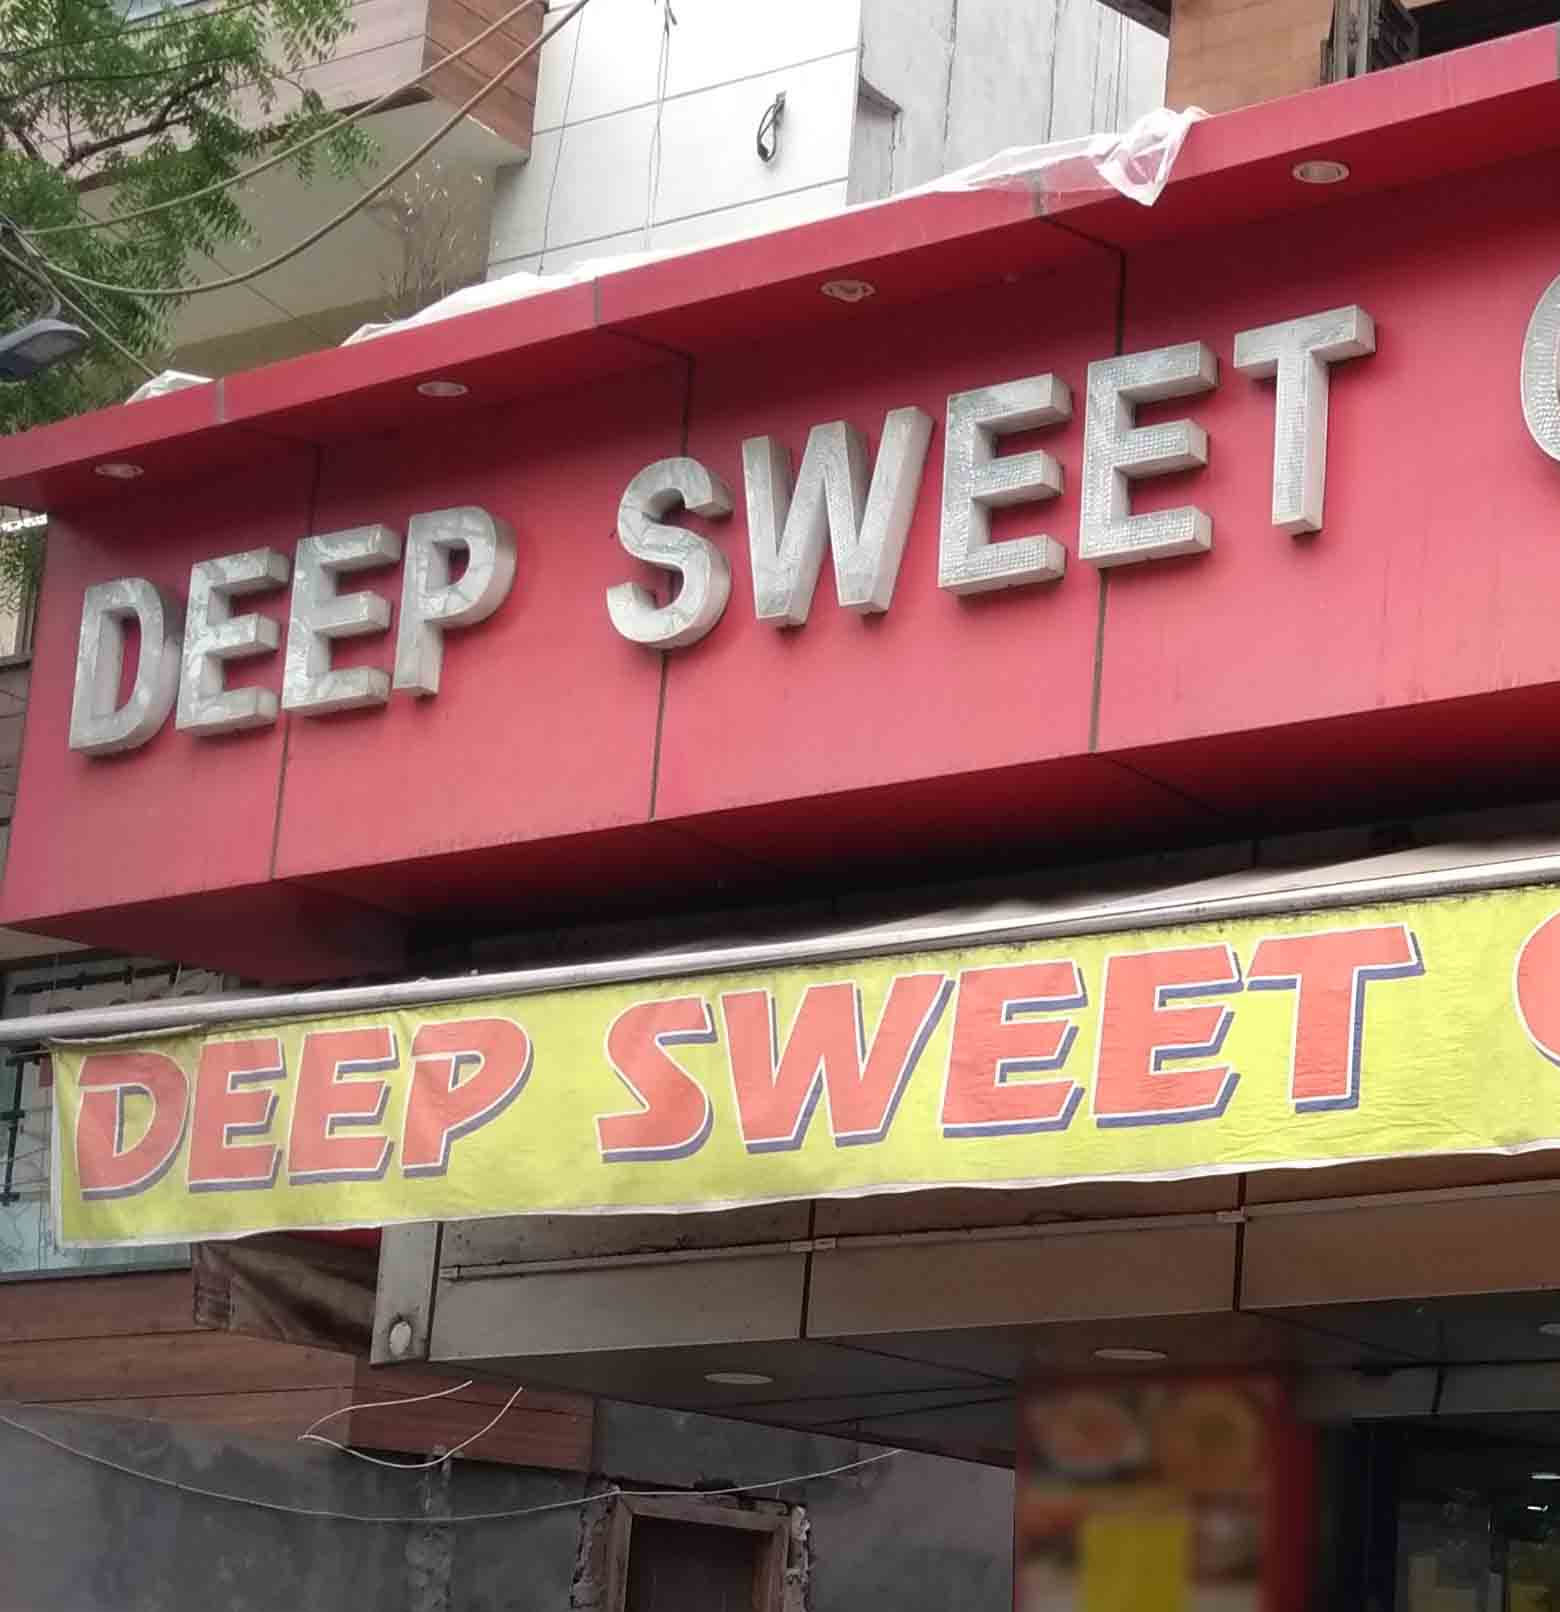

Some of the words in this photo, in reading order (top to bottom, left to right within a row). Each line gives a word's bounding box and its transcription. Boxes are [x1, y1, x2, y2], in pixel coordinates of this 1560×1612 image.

[69, 505, 517, 757] DEEP
[606, 304, 1377, 649] SWEET
[77, 1016, 533, 1202] DEEP
[598, 923, 1426, 1163] SWEET
